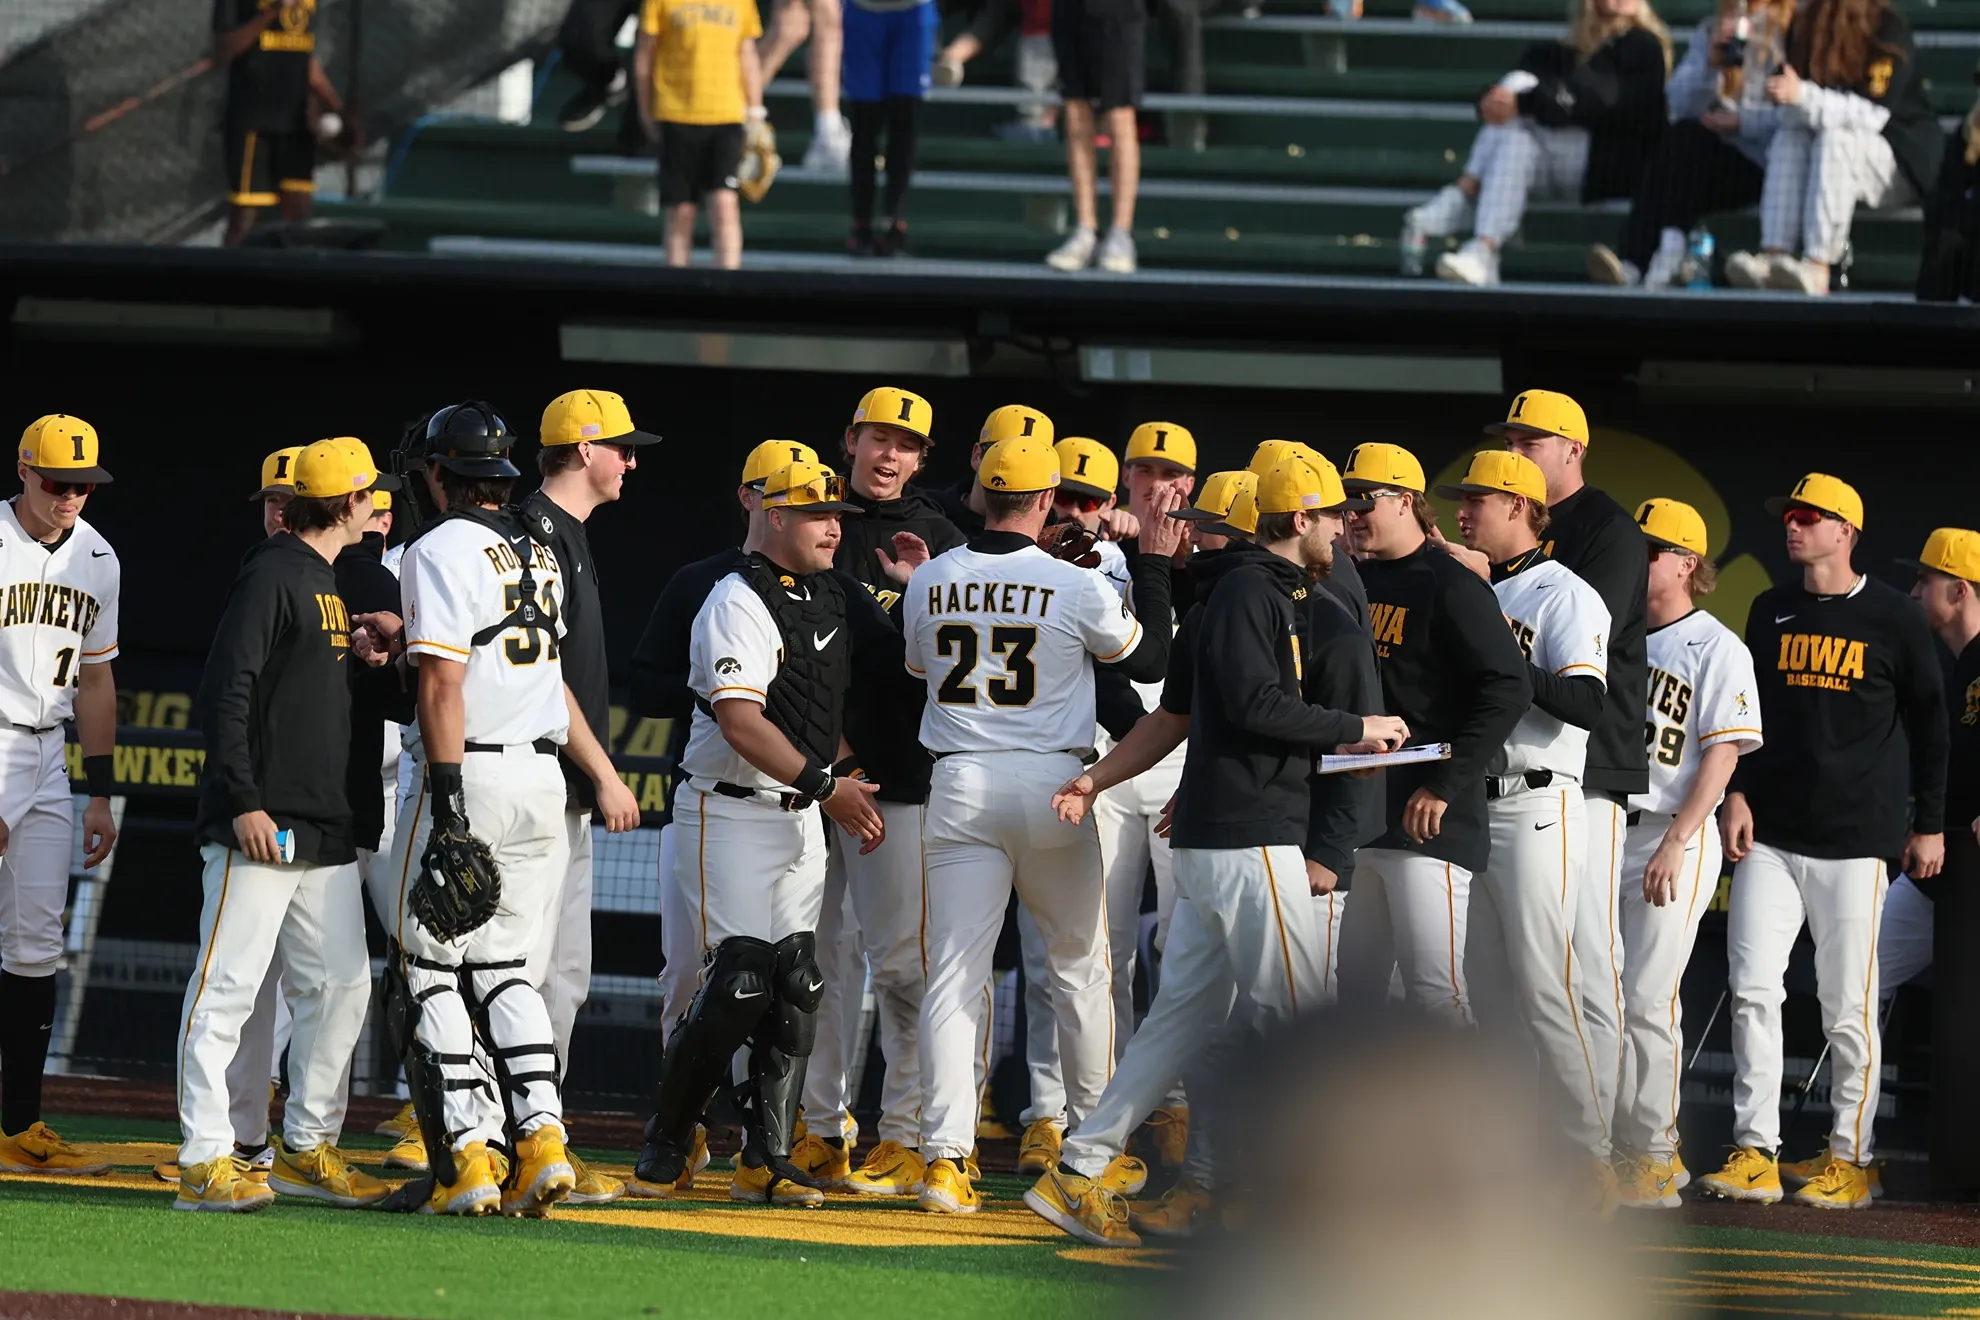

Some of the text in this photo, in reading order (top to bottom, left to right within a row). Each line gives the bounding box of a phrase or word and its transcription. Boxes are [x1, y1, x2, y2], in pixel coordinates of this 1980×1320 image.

[897, 397, 914, 422] I
[1512, 396, 1528, 418] I
[71, 436, 86, 461] I
[1153, 430, 1168, 452] I
[274, 456, 290, 479] I
[1074, 453, 1091, 477] I
[483, 542, 559, 575] RORS
[0, 582, 101, 639] AWKEYES
[928, 582, 1056, 618] HACKETT
[1367, 602, 1408, 646] WA
[51, 646, 80, 690] 1
[936, 621, 1039, 708] 23
[1777, 633, 1866, 680] IOWA
[1786, 673, 1852, 692] BASEBALL
[64, 742, 207, 787] HWKE
